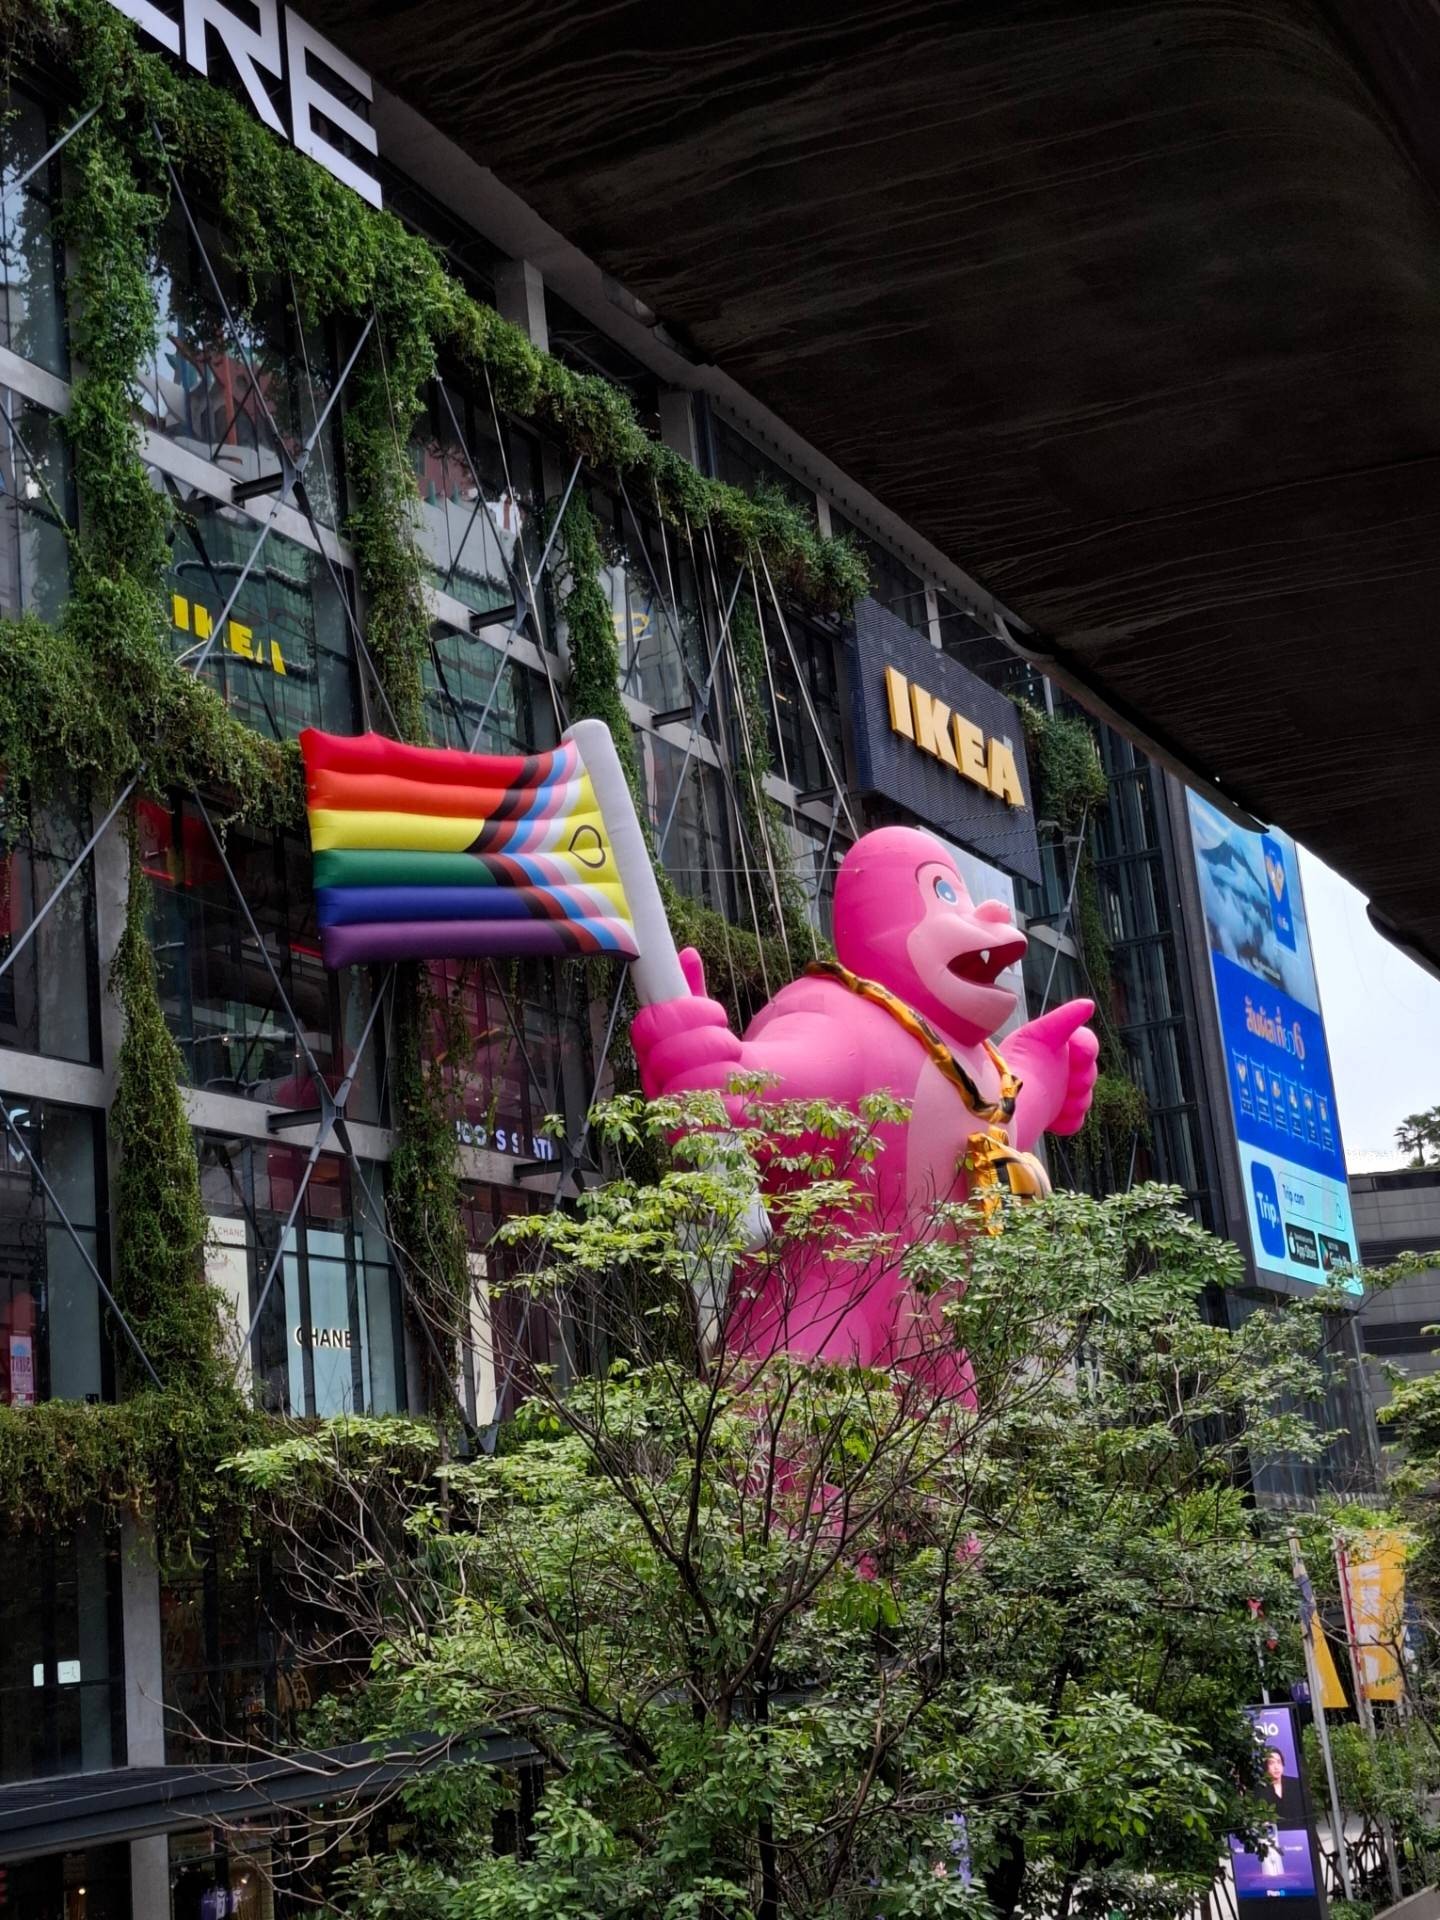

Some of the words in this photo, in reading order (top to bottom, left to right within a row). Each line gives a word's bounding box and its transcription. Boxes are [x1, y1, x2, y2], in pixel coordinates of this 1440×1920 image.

[106, 0, 383, 211] RE
[885, 665, 1025, 807] IKEA
[295, 1325, 361, 1349] CHANE
